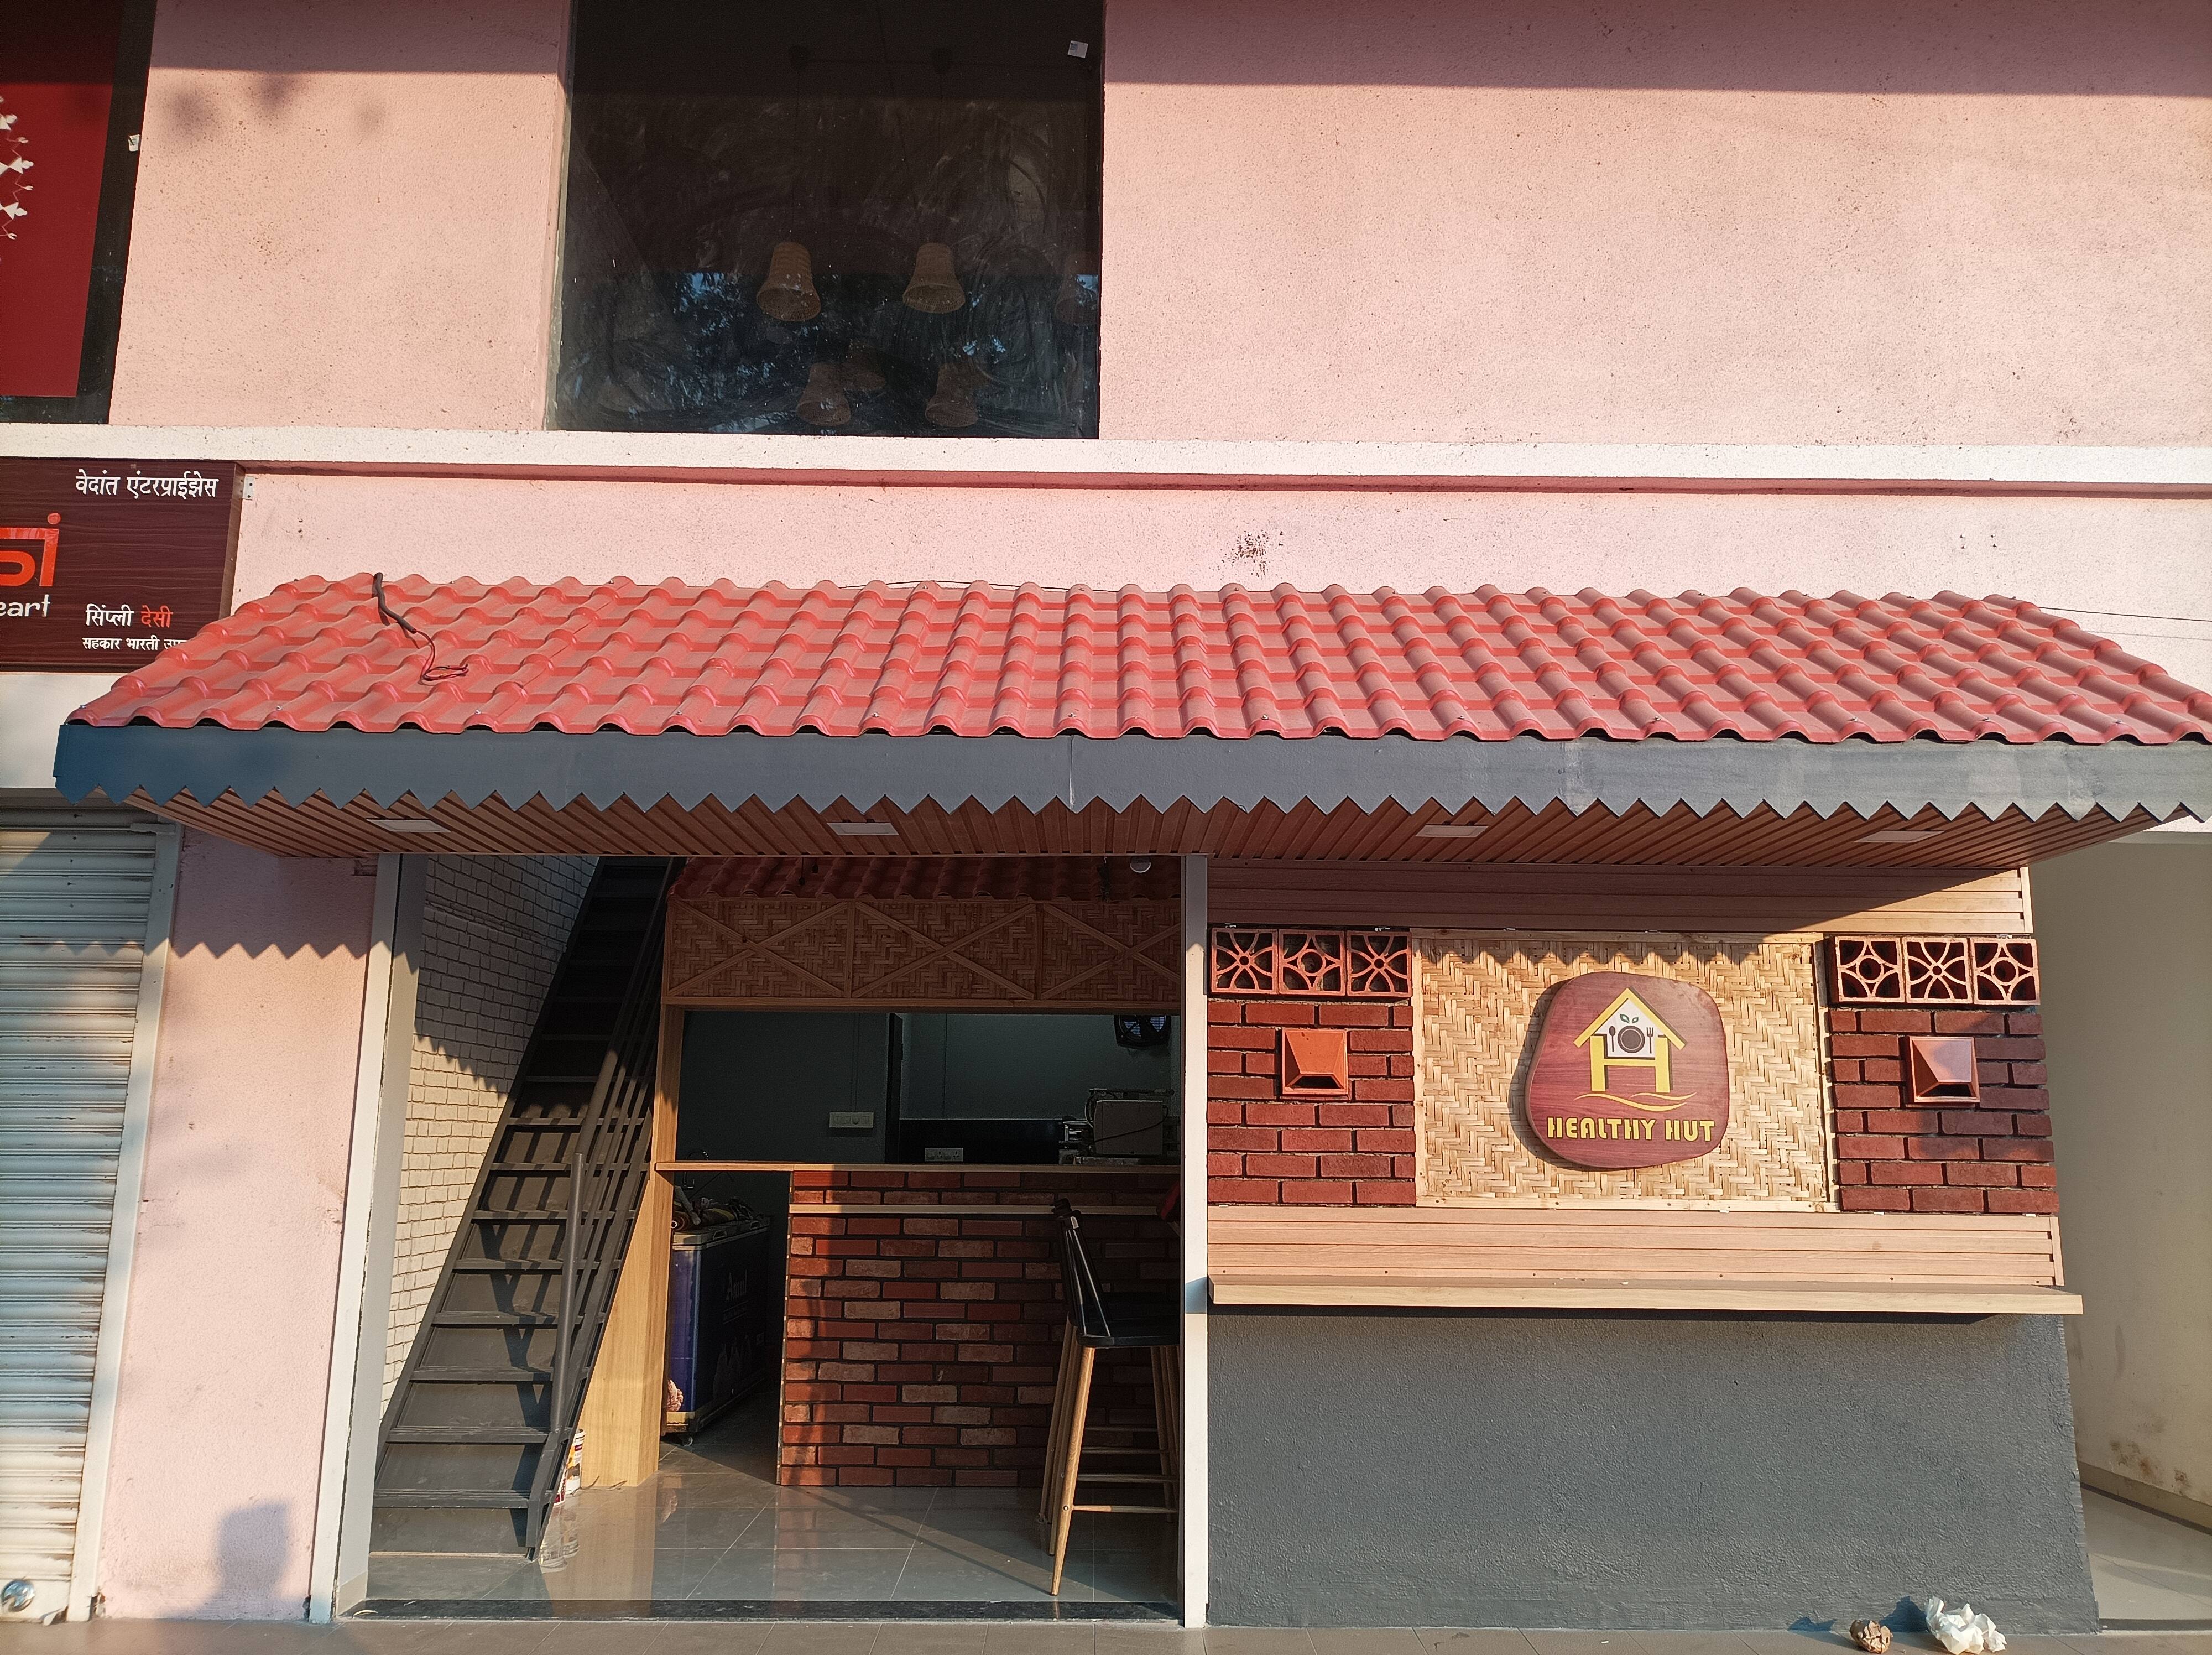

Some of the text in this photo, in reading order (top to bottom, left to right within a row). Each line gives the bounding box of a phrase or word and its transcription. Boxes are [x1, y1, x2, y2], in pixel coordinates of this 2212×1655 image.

[75, 469, 219, 499] वेदांत एंटरप्राईझेस
[86, 603, 173, 628] सिंप्ली देसी
[82, 638, 122, 650] सहकार
[126, 635, 160, 650] भारती
[1547, 1116, 1715, 1142] HEALTHY HUT
